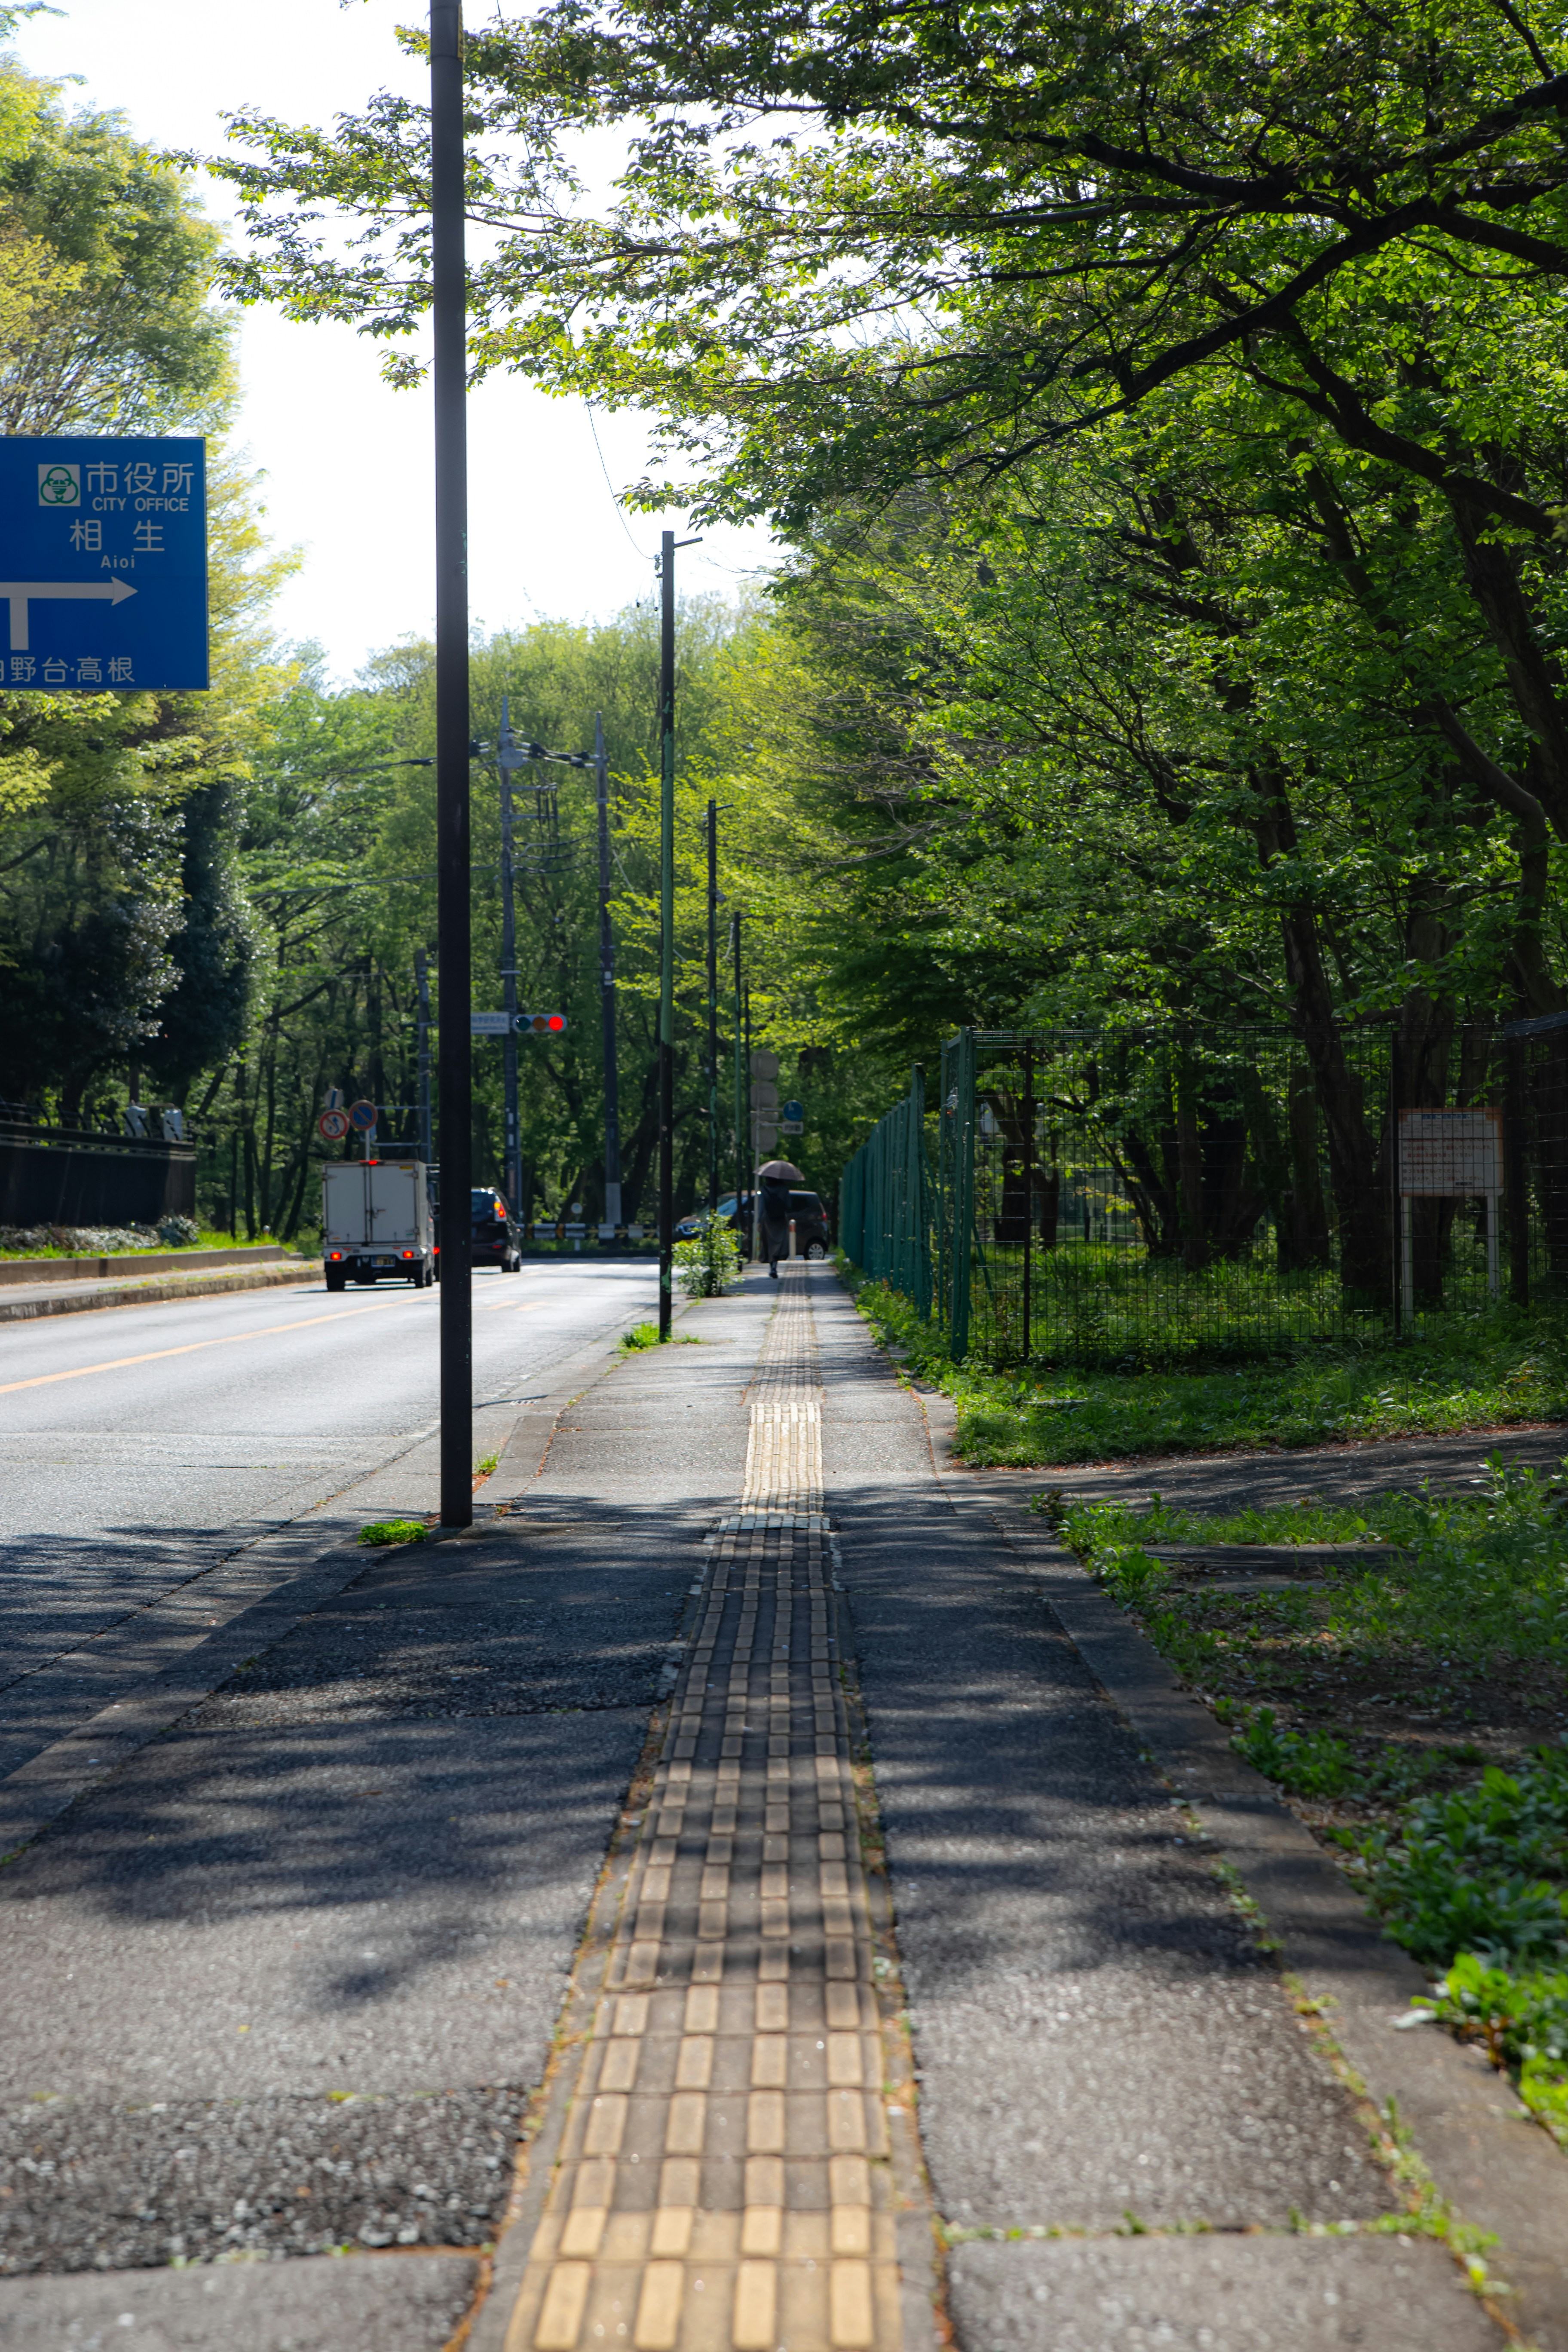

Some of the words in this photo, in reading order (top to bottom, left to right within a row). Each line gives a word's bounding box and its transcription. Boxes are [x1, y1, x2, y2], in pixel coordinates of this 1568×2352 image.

[85, 461, 195, 494] 市役所
[92, 497, 126, 511] CITY
[135, 497, 189, 511] OFFICE
[100, 555, 135, 568] Aioi
